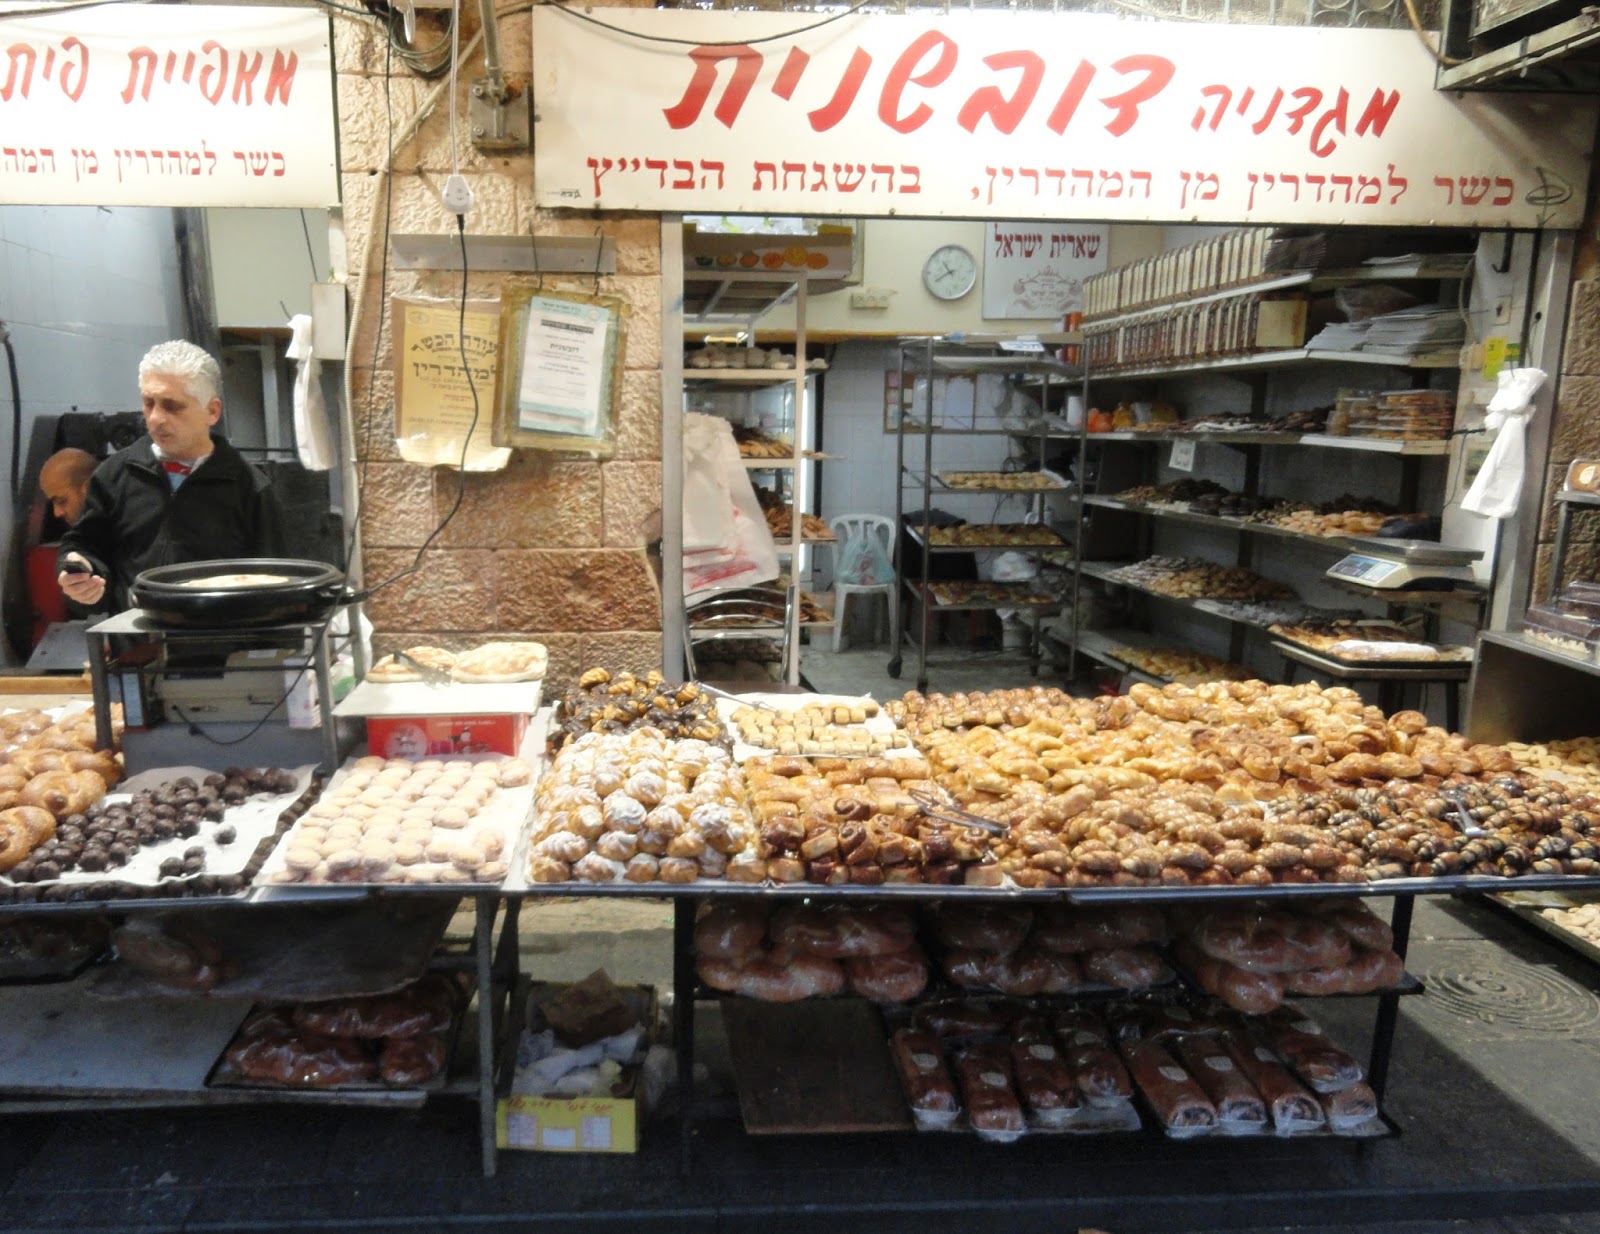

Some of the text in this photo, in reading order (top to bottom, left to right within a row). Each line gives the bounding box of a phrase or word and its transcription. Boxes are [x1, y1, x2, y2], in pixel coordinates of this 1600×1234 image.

[121, 40, 299, 106] מאפיית
[661, 29, 1402, 159] מגדניה דובשנית
[71, 148, 98, 183] מן
[114, 139, 217, 183] למהדרין
[233, 150, 286, 177] כשר
[752, 159, 921, 195] בהשגחת
[971, 166, 1153, 204] המהדרין,
[1180, 171, 1219, 210] מן
[1247, 163, 1409, 211] למהדרין
[1433, 175, 1515, 207] כשר
[994, 222, 1101, 259] שארית ישראל
